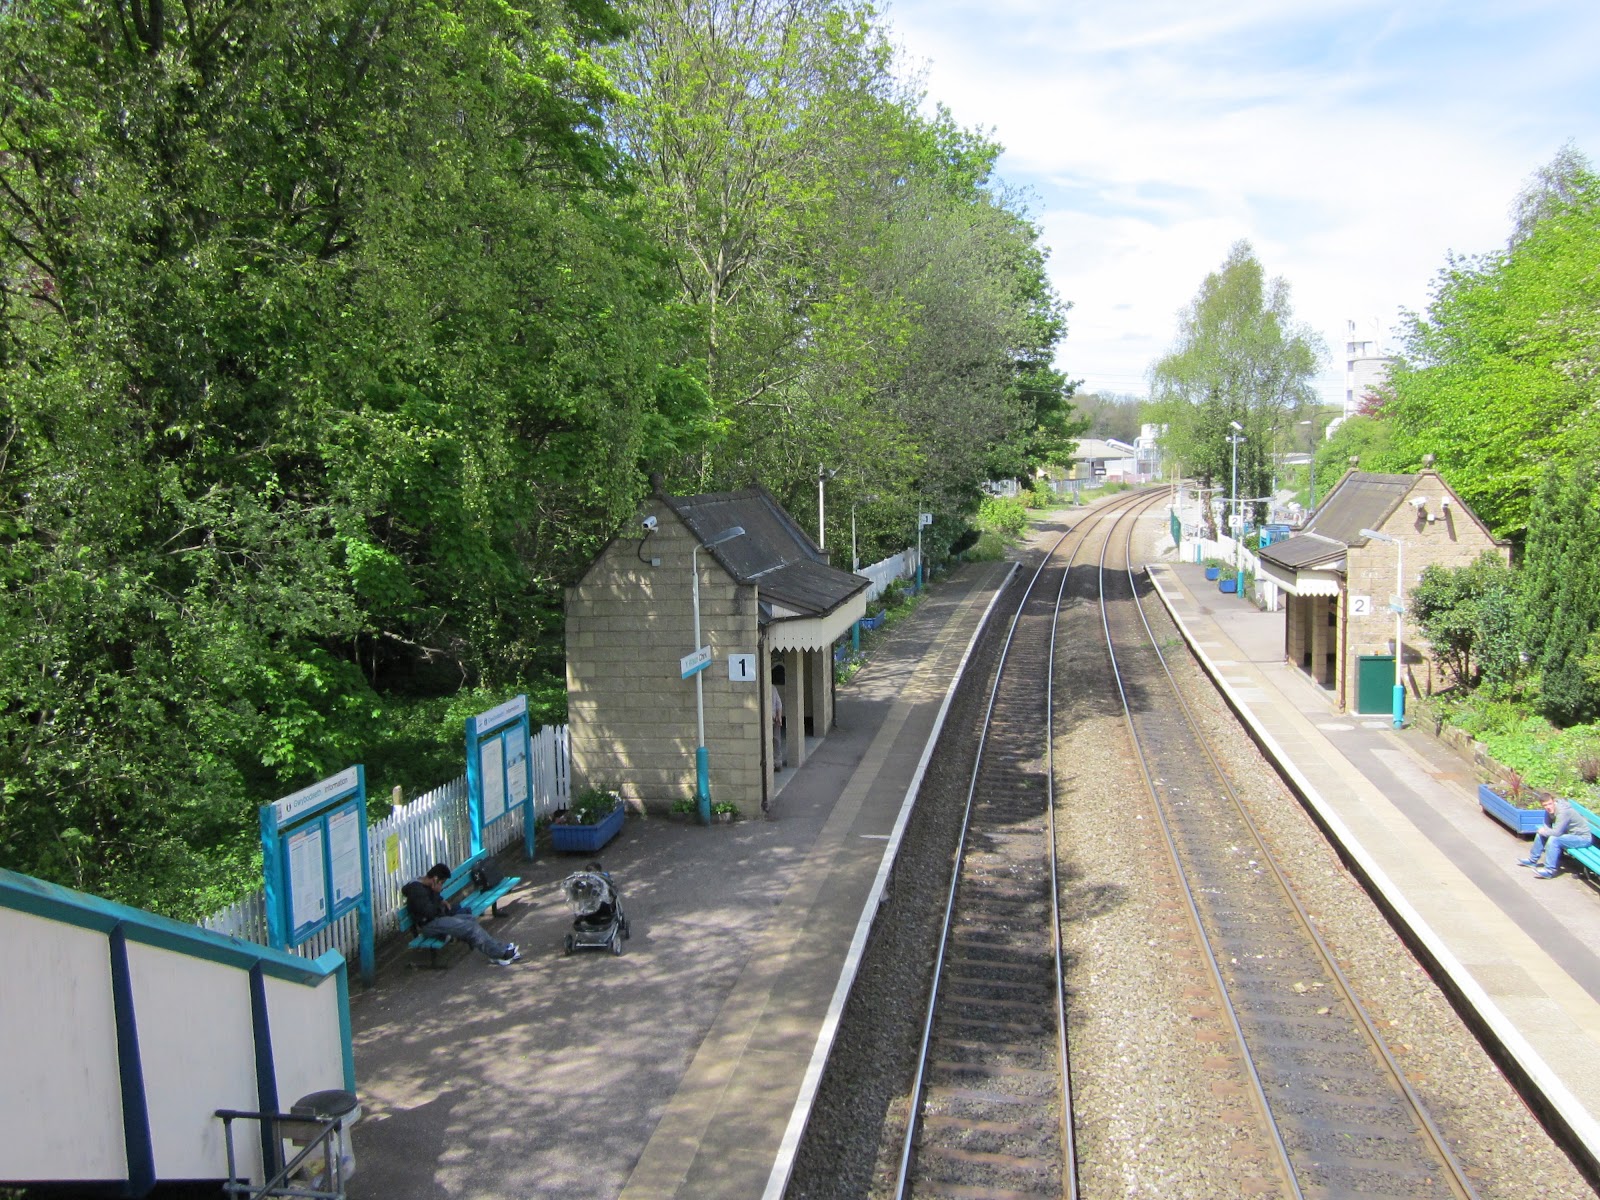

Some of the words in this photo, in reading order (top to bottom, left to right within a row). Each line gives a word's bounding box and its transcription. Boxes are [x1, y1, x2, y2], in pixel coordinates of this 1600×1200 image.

[1232, 517, 1238, 525] 2
[1355, 599, 1364, 612] 2
[738, 658, 746, 677] 1
